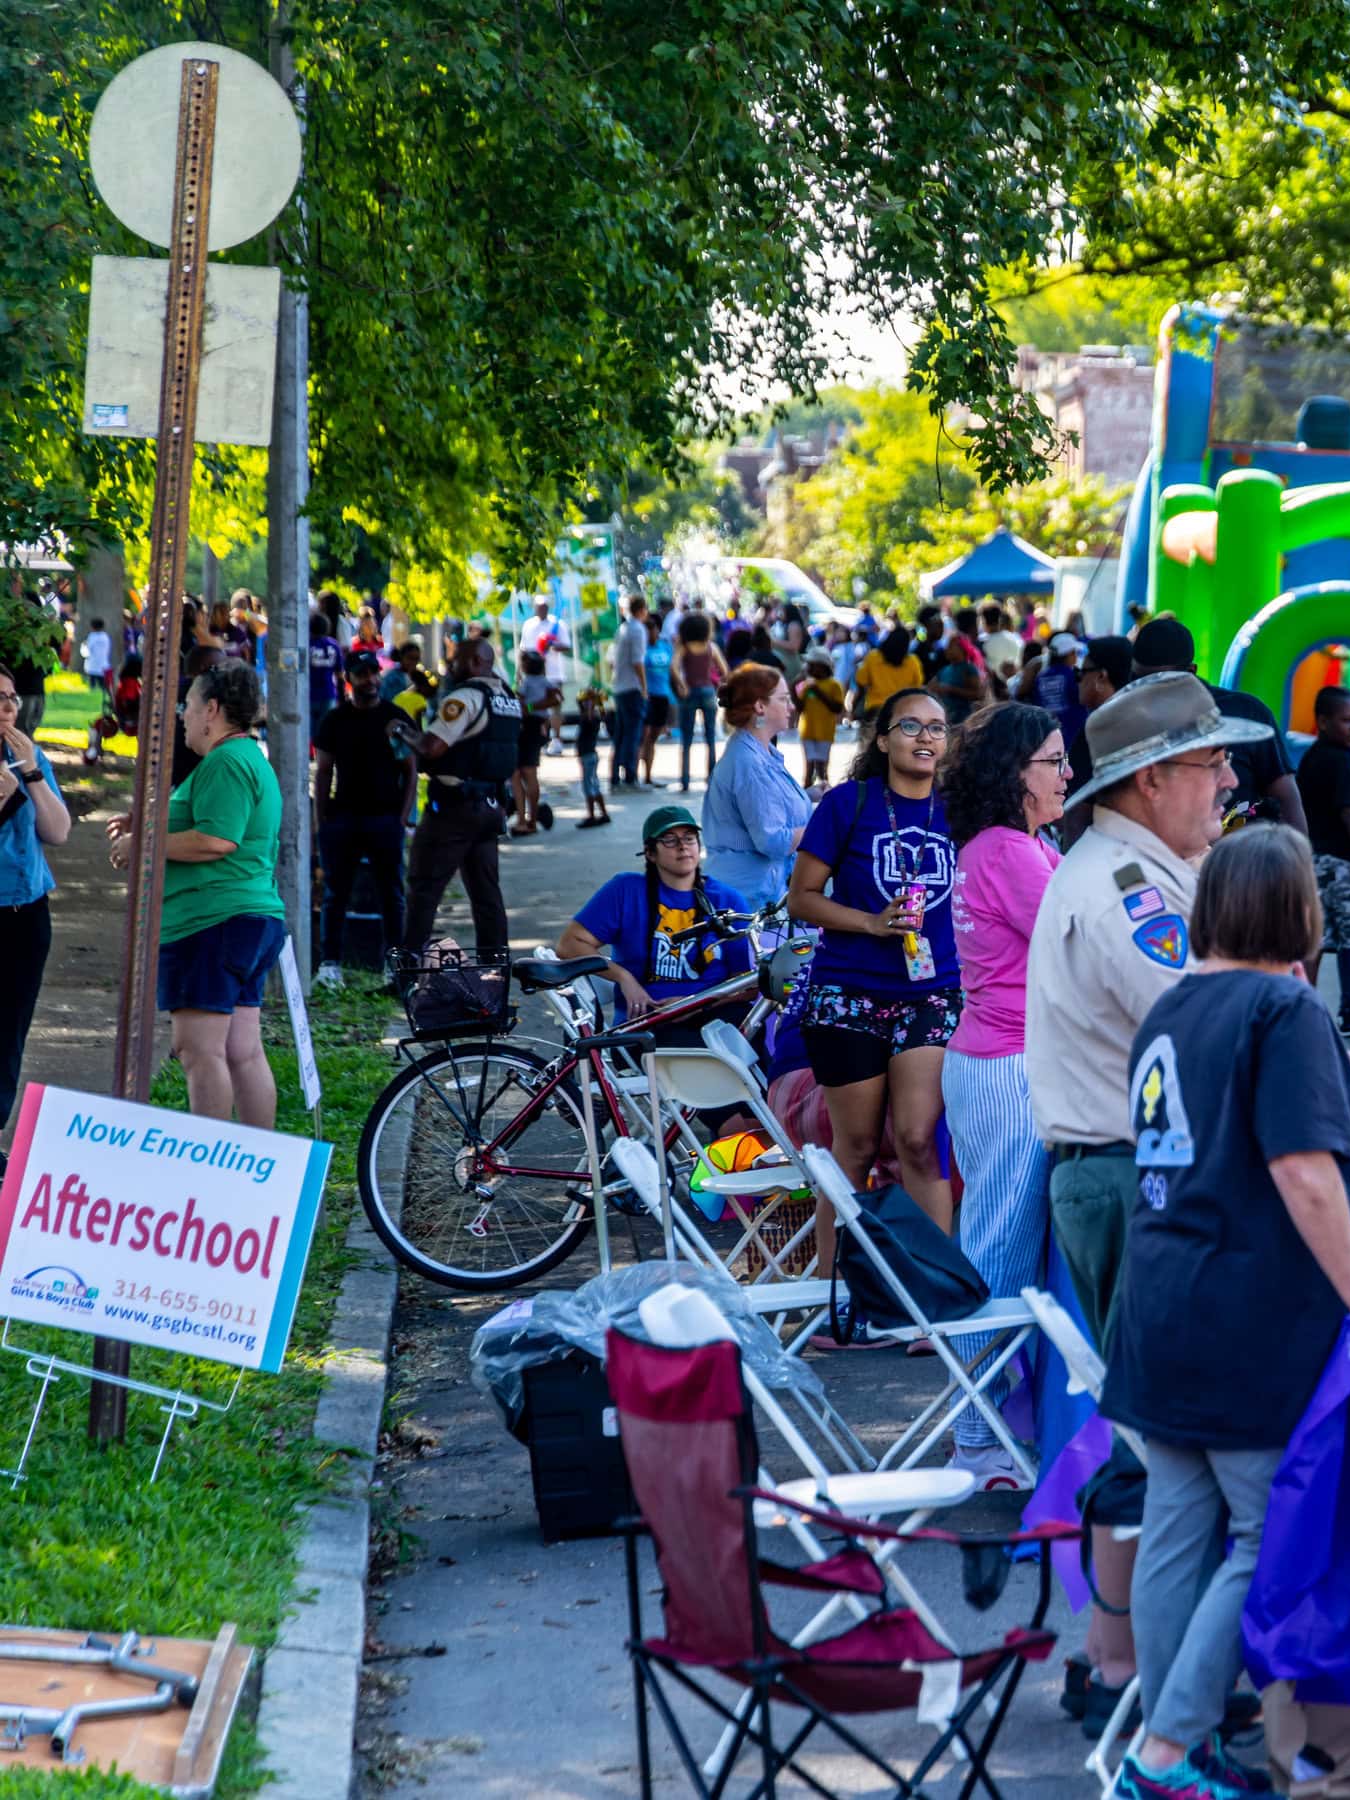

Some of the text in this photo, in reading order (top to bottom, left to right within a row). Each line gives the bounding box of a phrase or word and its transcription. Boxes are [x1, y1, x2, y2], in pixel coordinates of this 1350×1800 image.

[66, 1113, 276, 1183] Now Enrolling
[20, 1173, 280, 1278] Afterschool
[11, 1286, 34, 1299] Girls
[46, 1291, 70, 1306] Boys
[71, 1297, 95, 1311] Club
[112, 1279, 257, 1327] 314-655-9011
[104, 1303, 257, 1351] www.gsgbcstl.org
